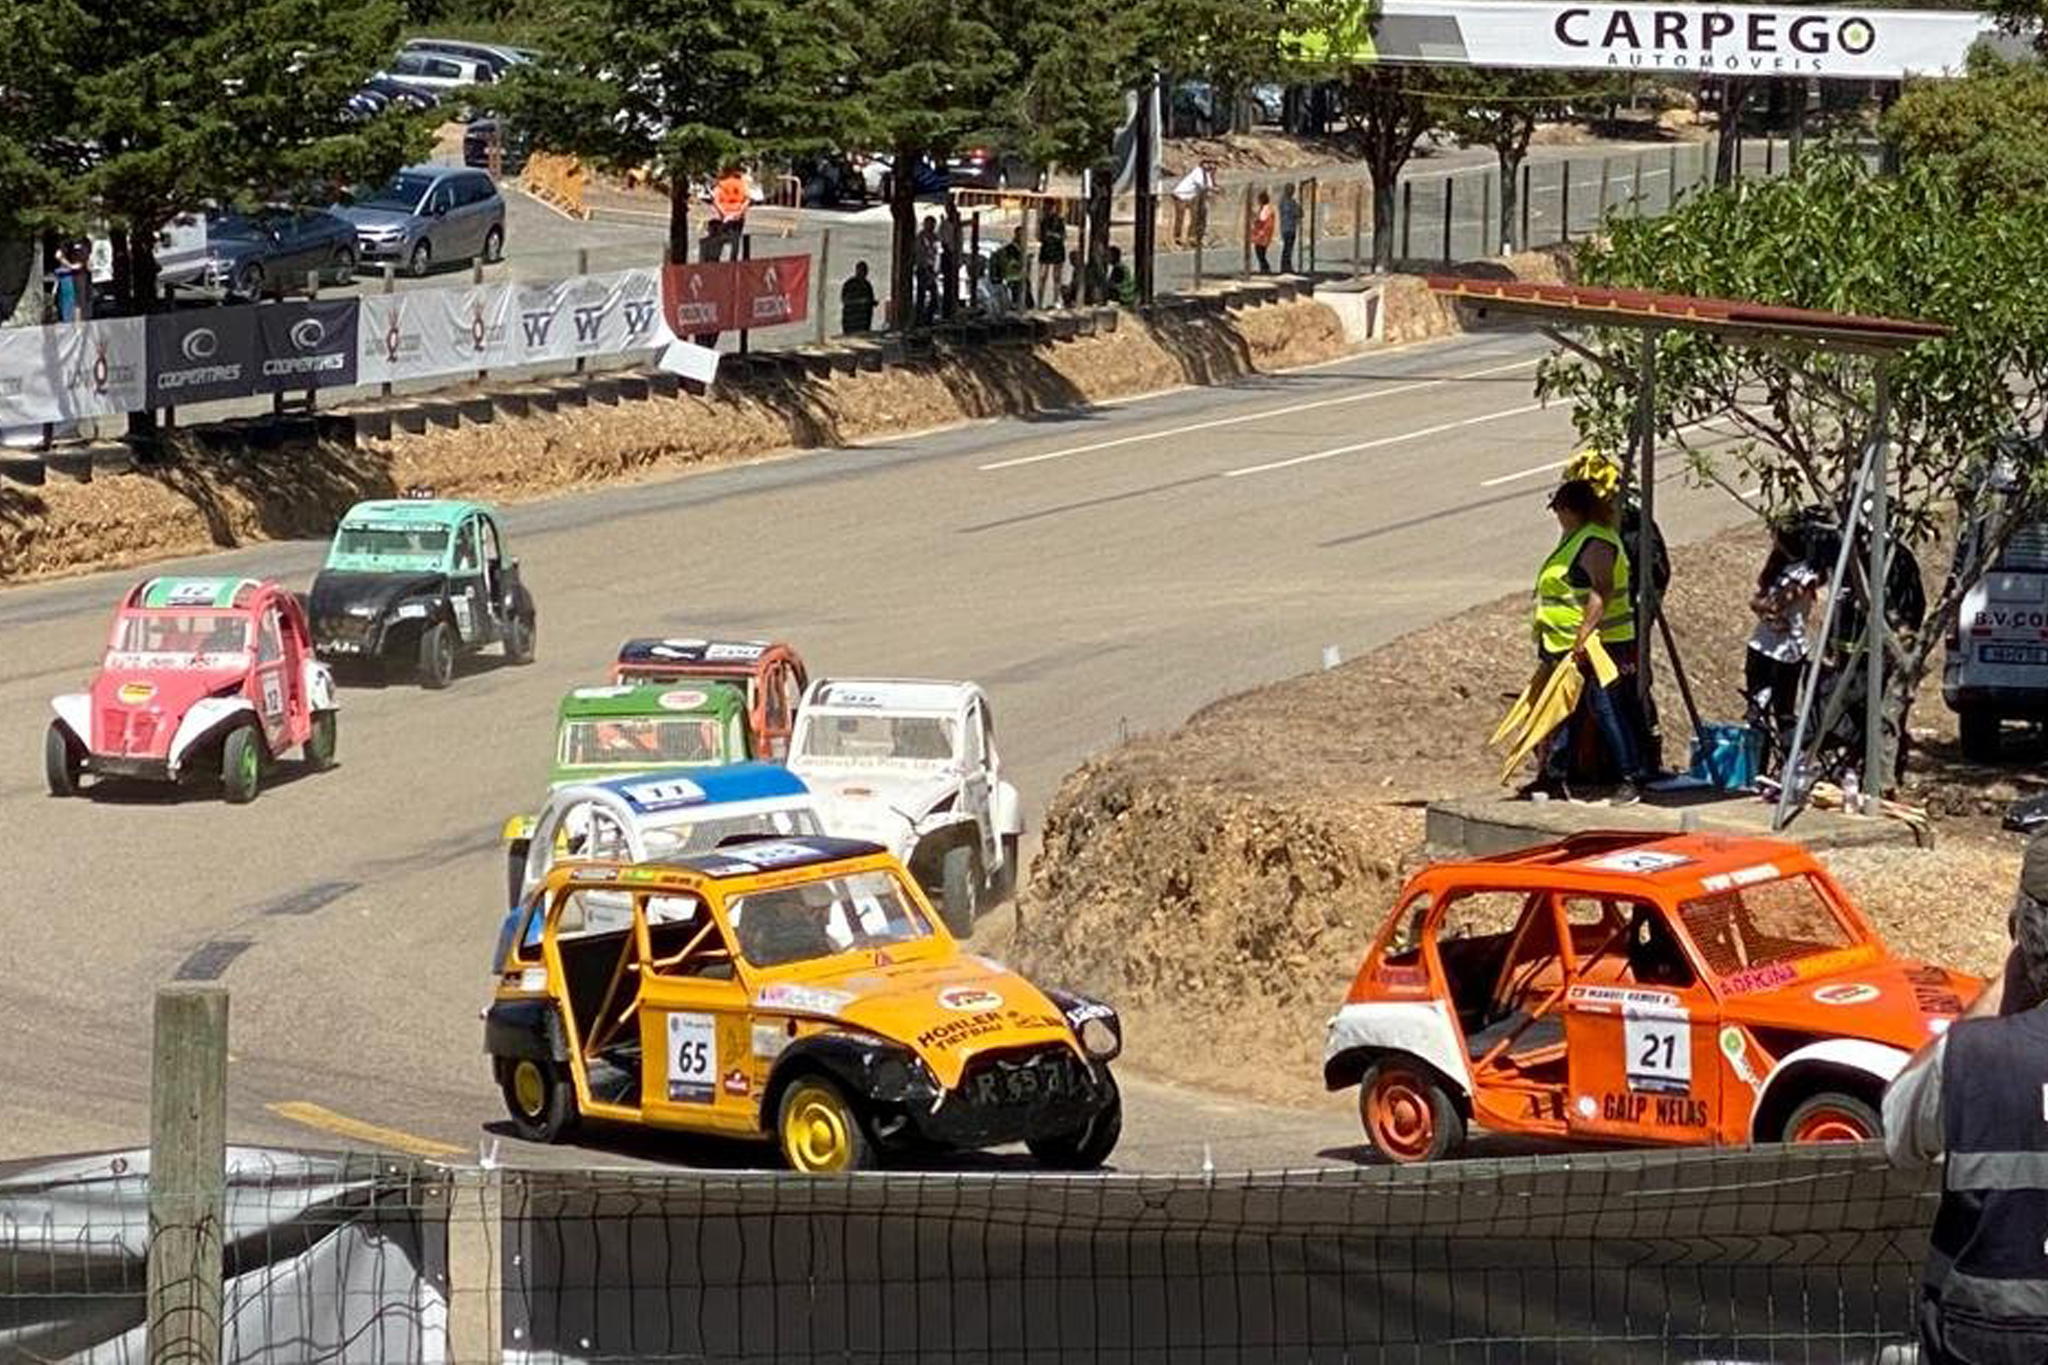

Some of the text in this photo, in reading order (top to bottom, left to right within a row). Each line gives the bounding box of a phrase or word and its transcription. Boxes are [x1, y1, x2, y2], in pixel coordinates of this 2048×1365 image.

[1554, 8, 1876, 55] CARPEGO
[1607, 51, 1822, 72] AUTOMÓVEIS
[678, 1040, 708, 1076] 65
[1639, 1033, 1677, 1070] 21
[1603, 1091, 1708, 1128] GALP NELAS
